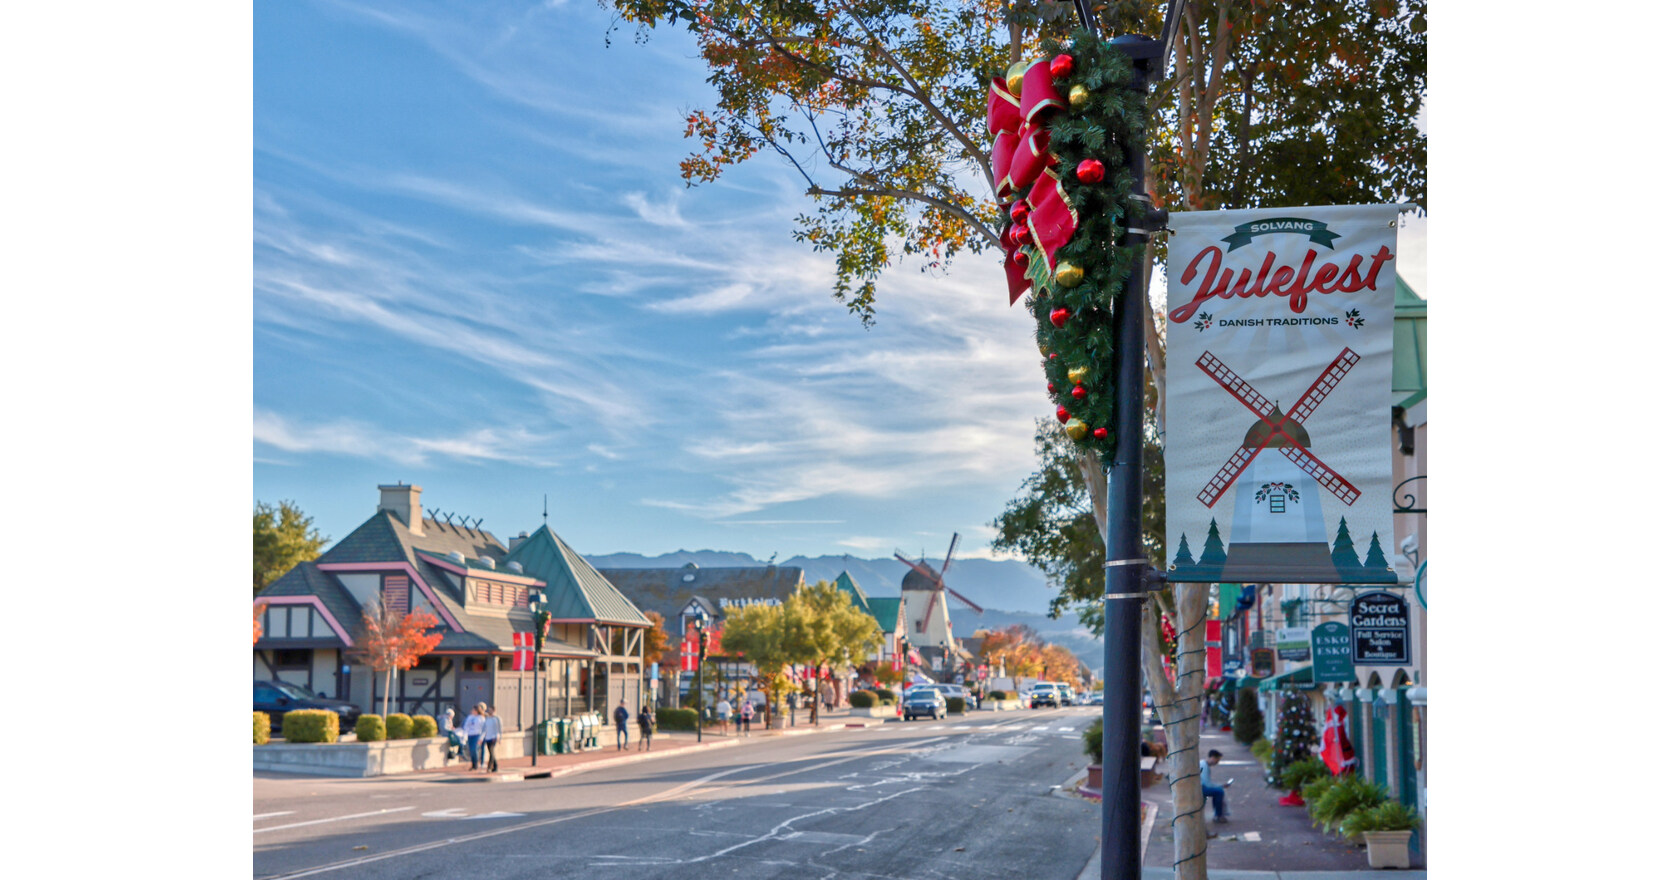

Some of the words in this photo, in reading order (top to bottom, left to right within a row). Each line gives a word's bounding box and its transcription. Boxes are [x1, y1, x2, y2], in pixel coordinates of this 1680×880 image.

[1250, 221, 1314, 233] SOLVANG
[1168, 244, 1395, 324] Julefest
[1219, 318, 1264, 327] DANISH
[1266, 317, 1339, 326] TRADITIONS
[1358, 602, 1399, 614] Secret
[1352, 614, 1407, 627] Gardens
[1357, 631, 1372, 639] Full
